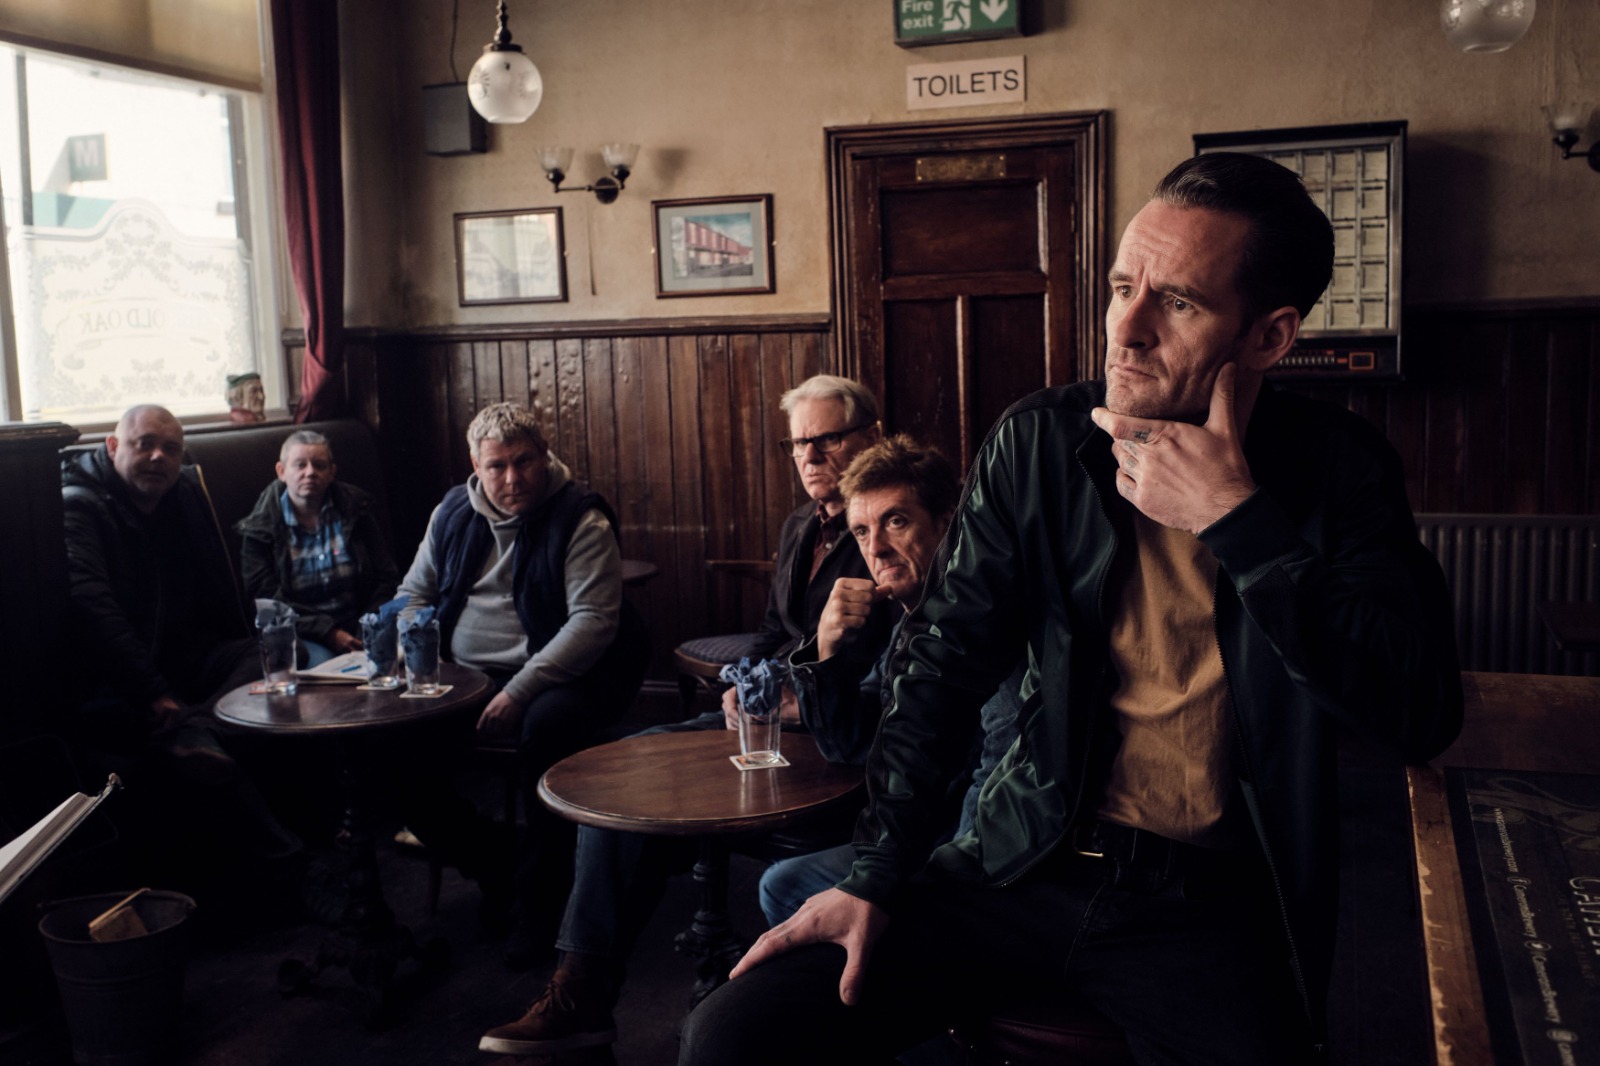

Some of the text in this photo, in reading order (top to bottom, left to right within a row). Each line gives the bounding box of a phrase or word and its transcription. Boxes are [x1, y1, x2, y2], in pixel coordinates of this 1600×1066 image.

[902, 0, 934, 13] Fire
[902, 15, 934, 30] exit
[913, 69, 1019, 97] TOILETS
[74, 139, 99, 168] M
